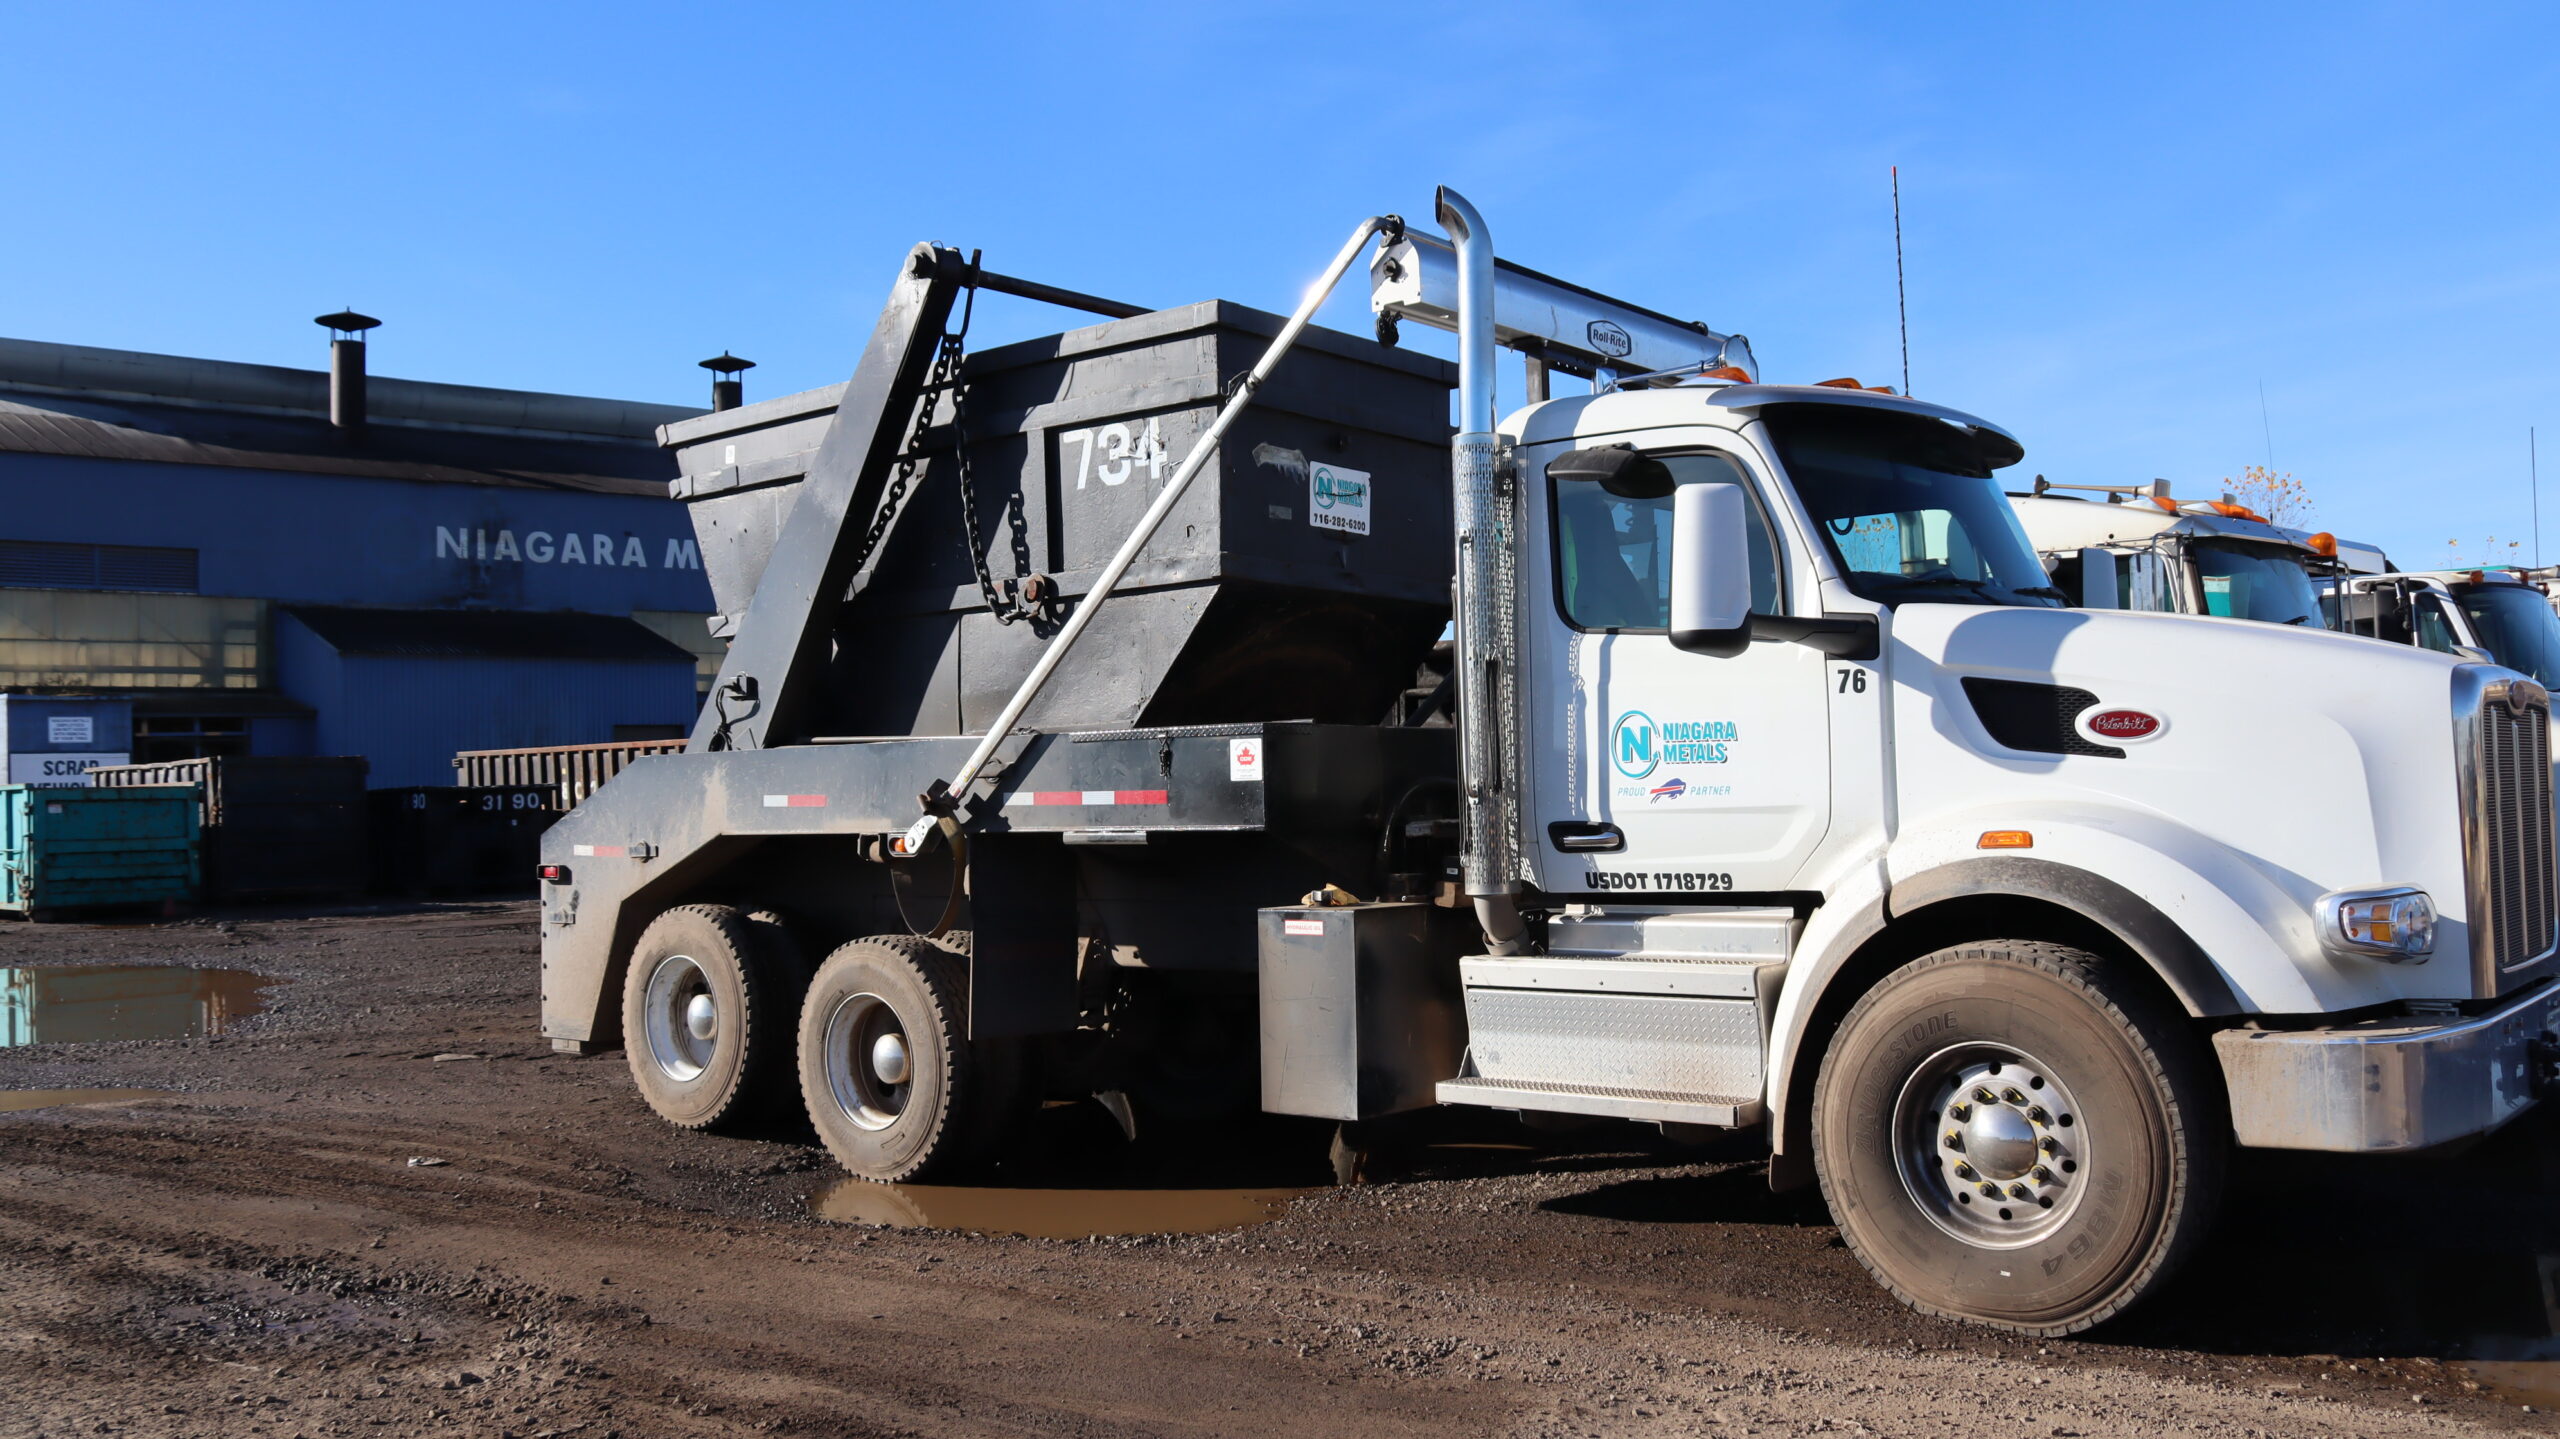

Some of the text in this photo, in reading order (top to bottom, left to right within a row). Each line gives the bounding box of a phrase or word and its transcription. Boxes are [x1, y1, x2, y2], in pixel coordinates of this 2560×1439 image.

[1062, 416, 1168, 490] 734
[436, 525, 648, 568] NIAGARA
[1837, 669, 1867, 694] 76
[1662, 720, 1738, 742] NIAGARA
[2095, 715, 2152, 732] Peterbilt
[1621, 726, 1652, 763] N
[1663, 743, 1728, 764] METALS
[1617, 786, 1731, 797] PROUD PARTNER
[1585, 872, 1733, 891] USDOT 1718729
[1855, 1009, 1959, 1157] BRIDGESTONE
